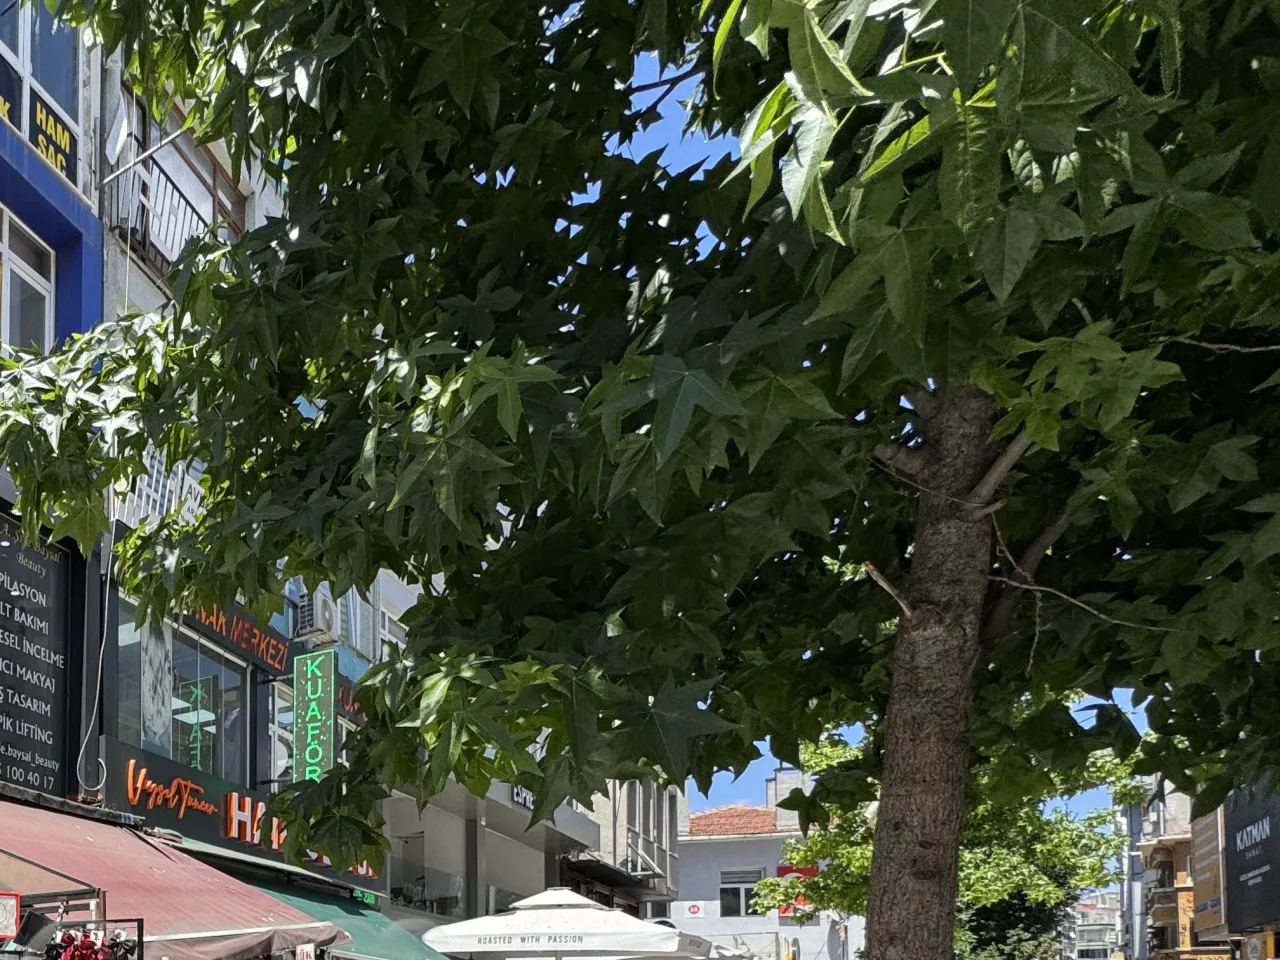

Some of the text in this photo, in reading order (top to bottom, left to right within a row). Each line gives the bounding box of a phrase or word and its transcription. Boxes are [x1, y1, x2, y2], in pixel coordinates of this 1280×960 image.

[36, 101, 70, 153] HAM
[16, 551, 47, 579] Beauty
[14, 608, 49, 635] BAKIMI
[23, 636, 65, 669] İNCELME
[230, 614, 290, 672] MERKEZİ
[16, 664, 56, 694] MAKYAJ
[6, 688, 51, 717] TASARIM
[16, 719, 53, 745] LİFTİNG
[304, 654, 325, 783] KUAFÖR
[6, 765, 25, 782] 100
[27, 772, 40, 787] 40
[43, 775, 55, 790] 17
[1236, 816, 1270, 852] KATMAN
[477, 935, 584, 945] ROASTED WITH PASSION
